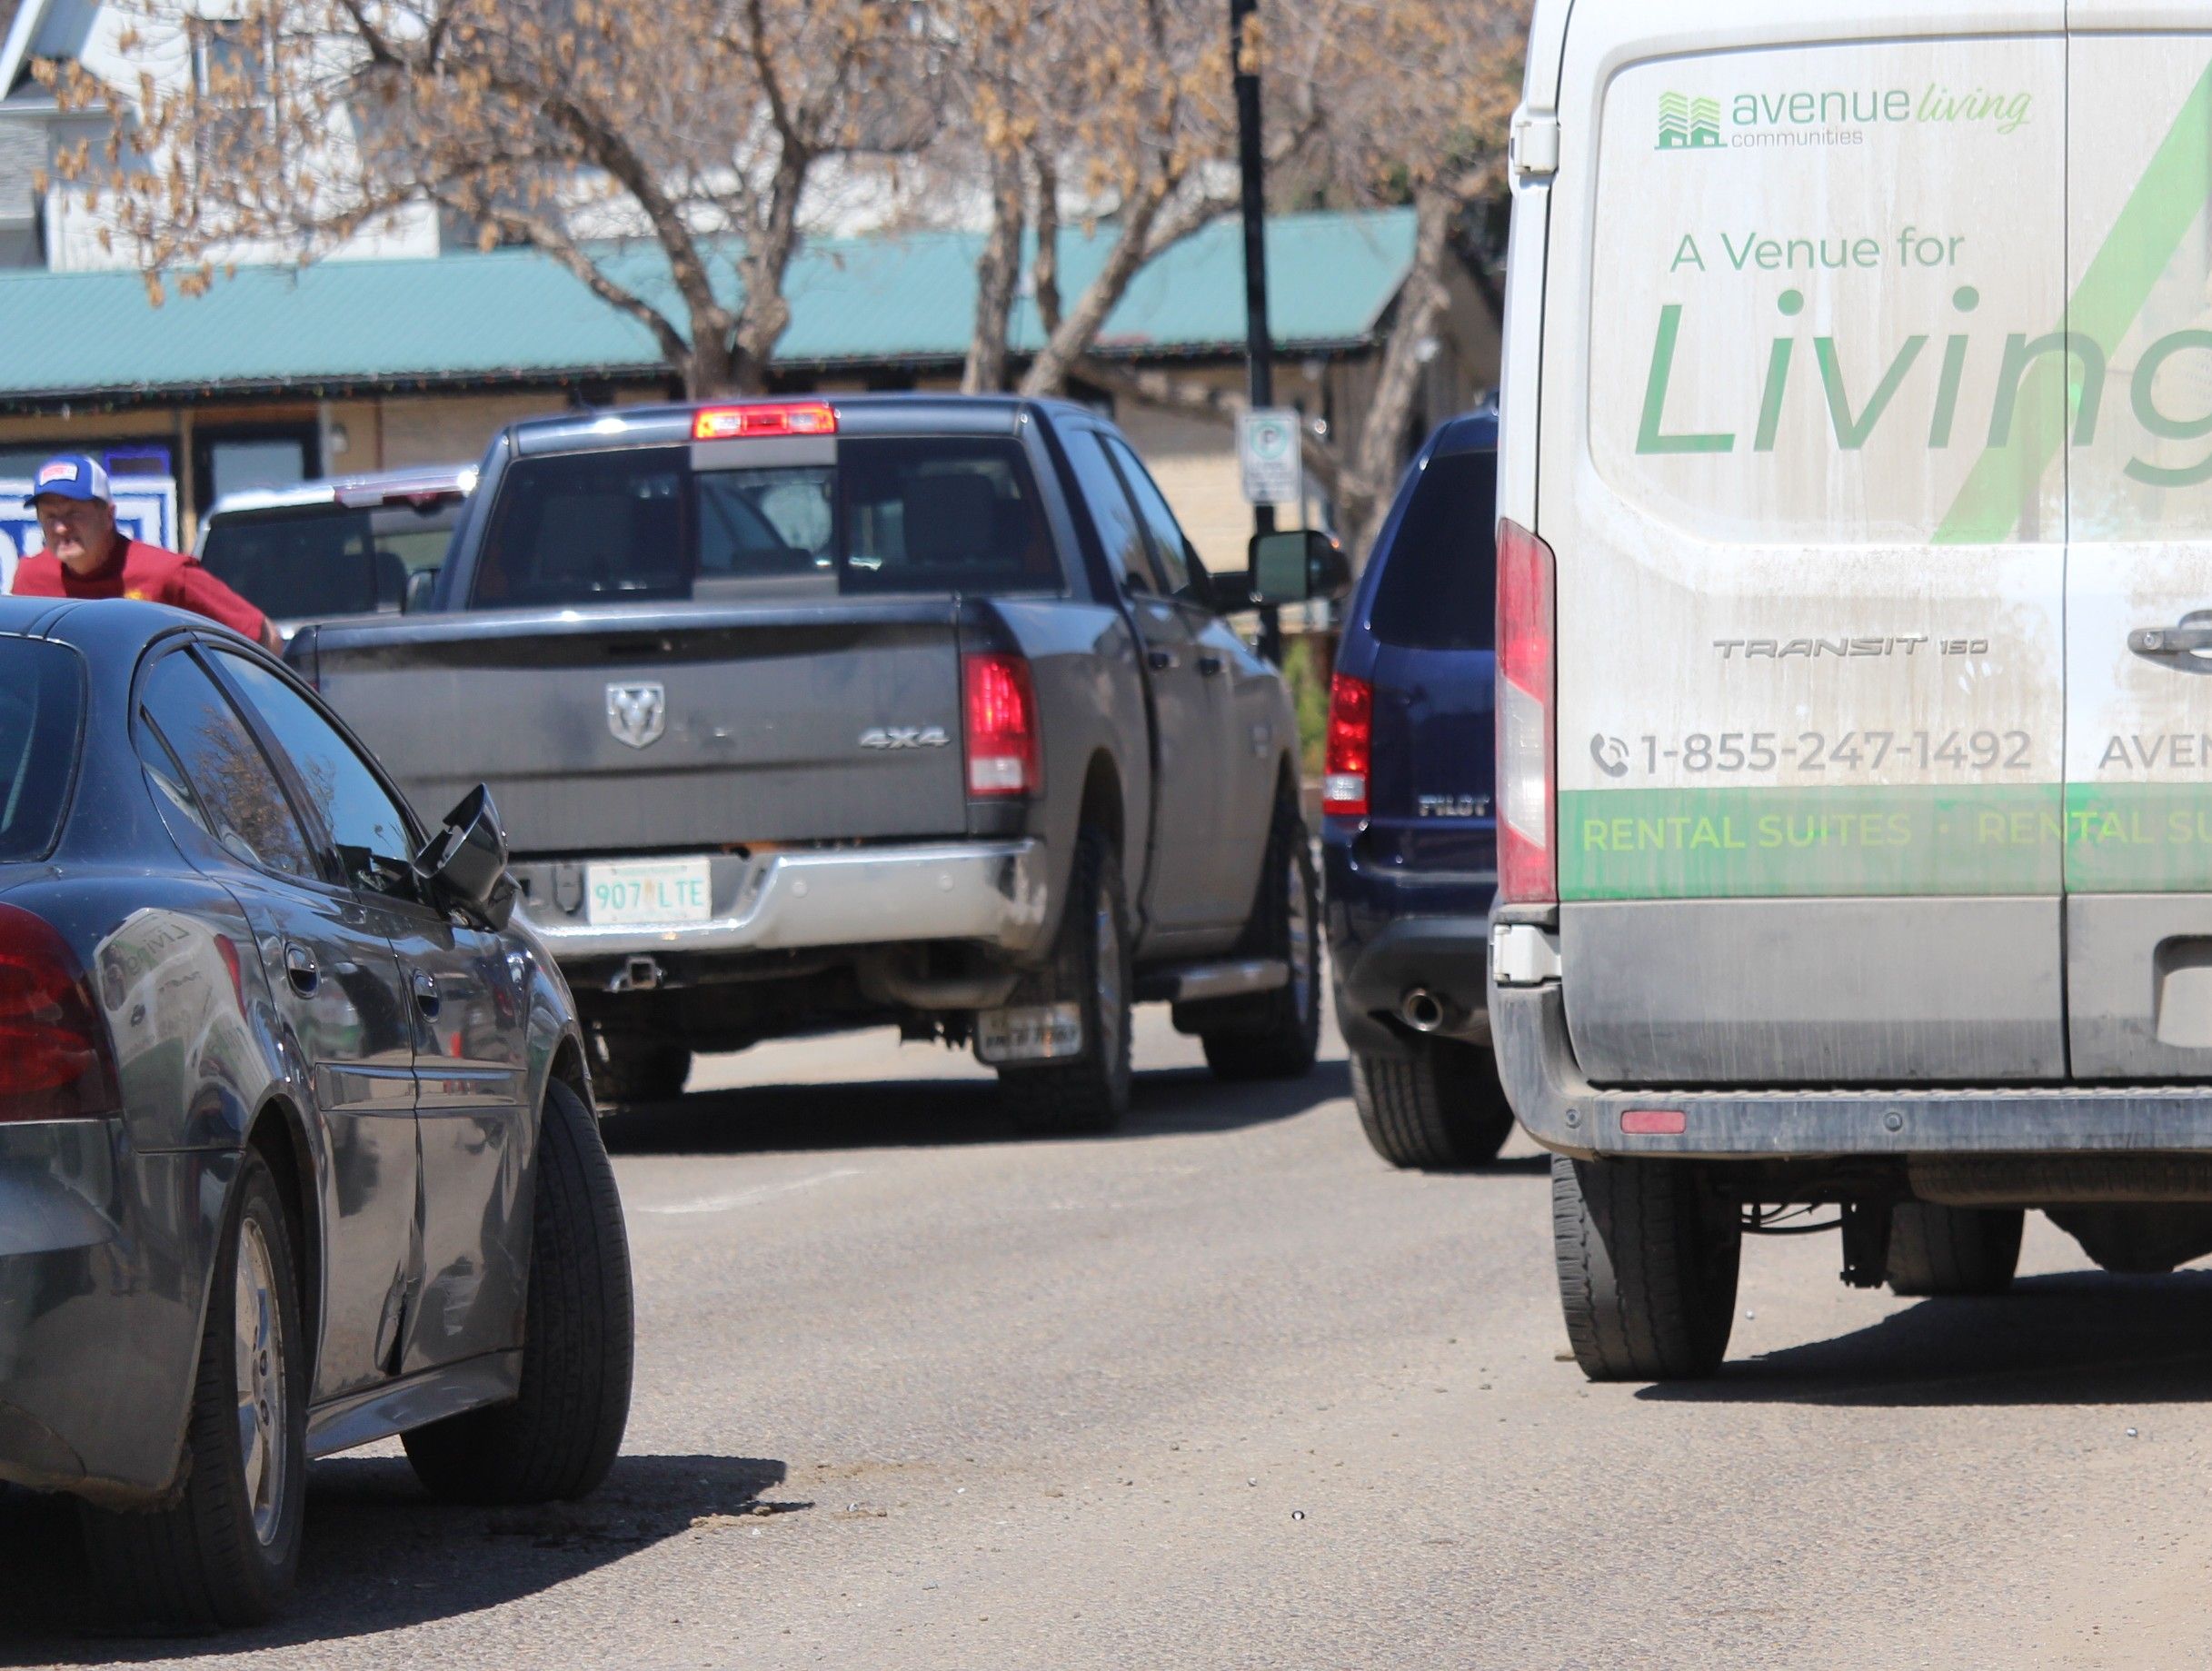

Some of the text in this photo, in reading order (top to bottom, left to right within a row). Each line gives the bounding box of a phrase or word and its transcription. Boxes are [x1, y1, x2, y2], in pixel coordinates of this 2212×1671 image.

[1732, 83, 2032, 134] avenue living
[1731, 128, 1864, 148] communities
[1669, 227, 1965, 273] A Venue for
[1635, 284, 2212, 488] Living
[1713, 636, 1928, 660] TRANSIT
[1640, 730, 2032, 774] 1-855-247-1492
[1418, 794, 1490, 817] PILOT
[1583, 815, 1746, 852] RENTAL
[1758, 812, 1911, 849] SUITES
[1978, 810, 2155, 845] RENTAL
[595, 877, 705, 910] 907 LTE
